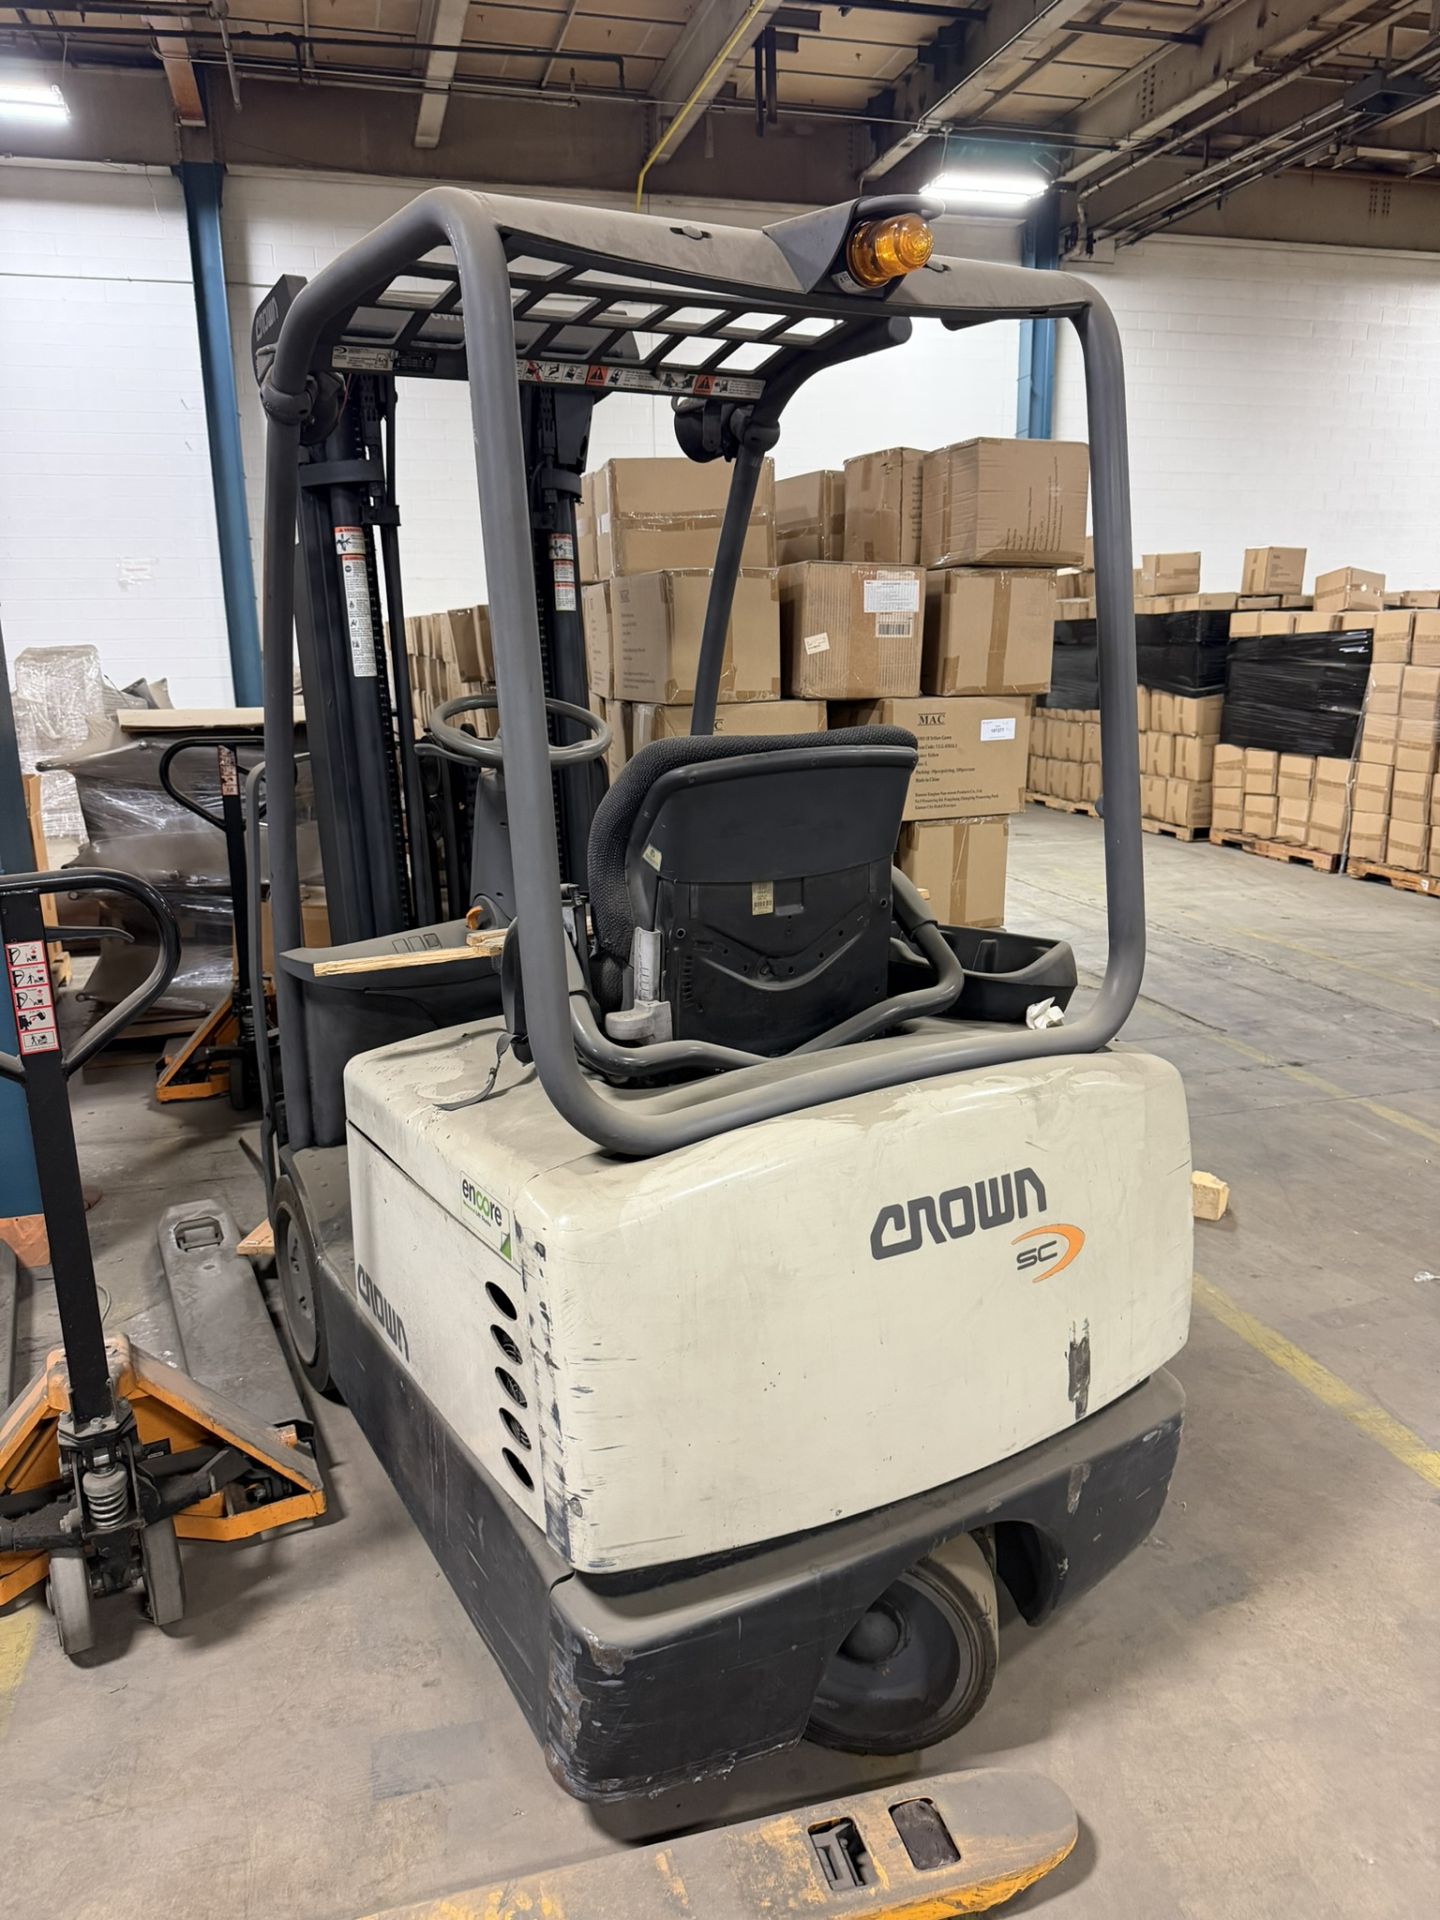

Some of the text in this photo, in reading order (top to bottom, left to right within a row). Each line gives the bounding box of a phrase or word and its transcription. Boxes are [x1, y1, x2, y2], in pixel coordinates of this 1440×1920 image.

[255, 296, 279, 342] CROWN
[919, 714, 946, 726] MAC
[462, 1179, 502, 1227] encore
[870, 1167, 1047, 1260] CROWN
[1016, 1240, 1058, 1270] SC
[357, 1263, 410, 1363] CROWN
